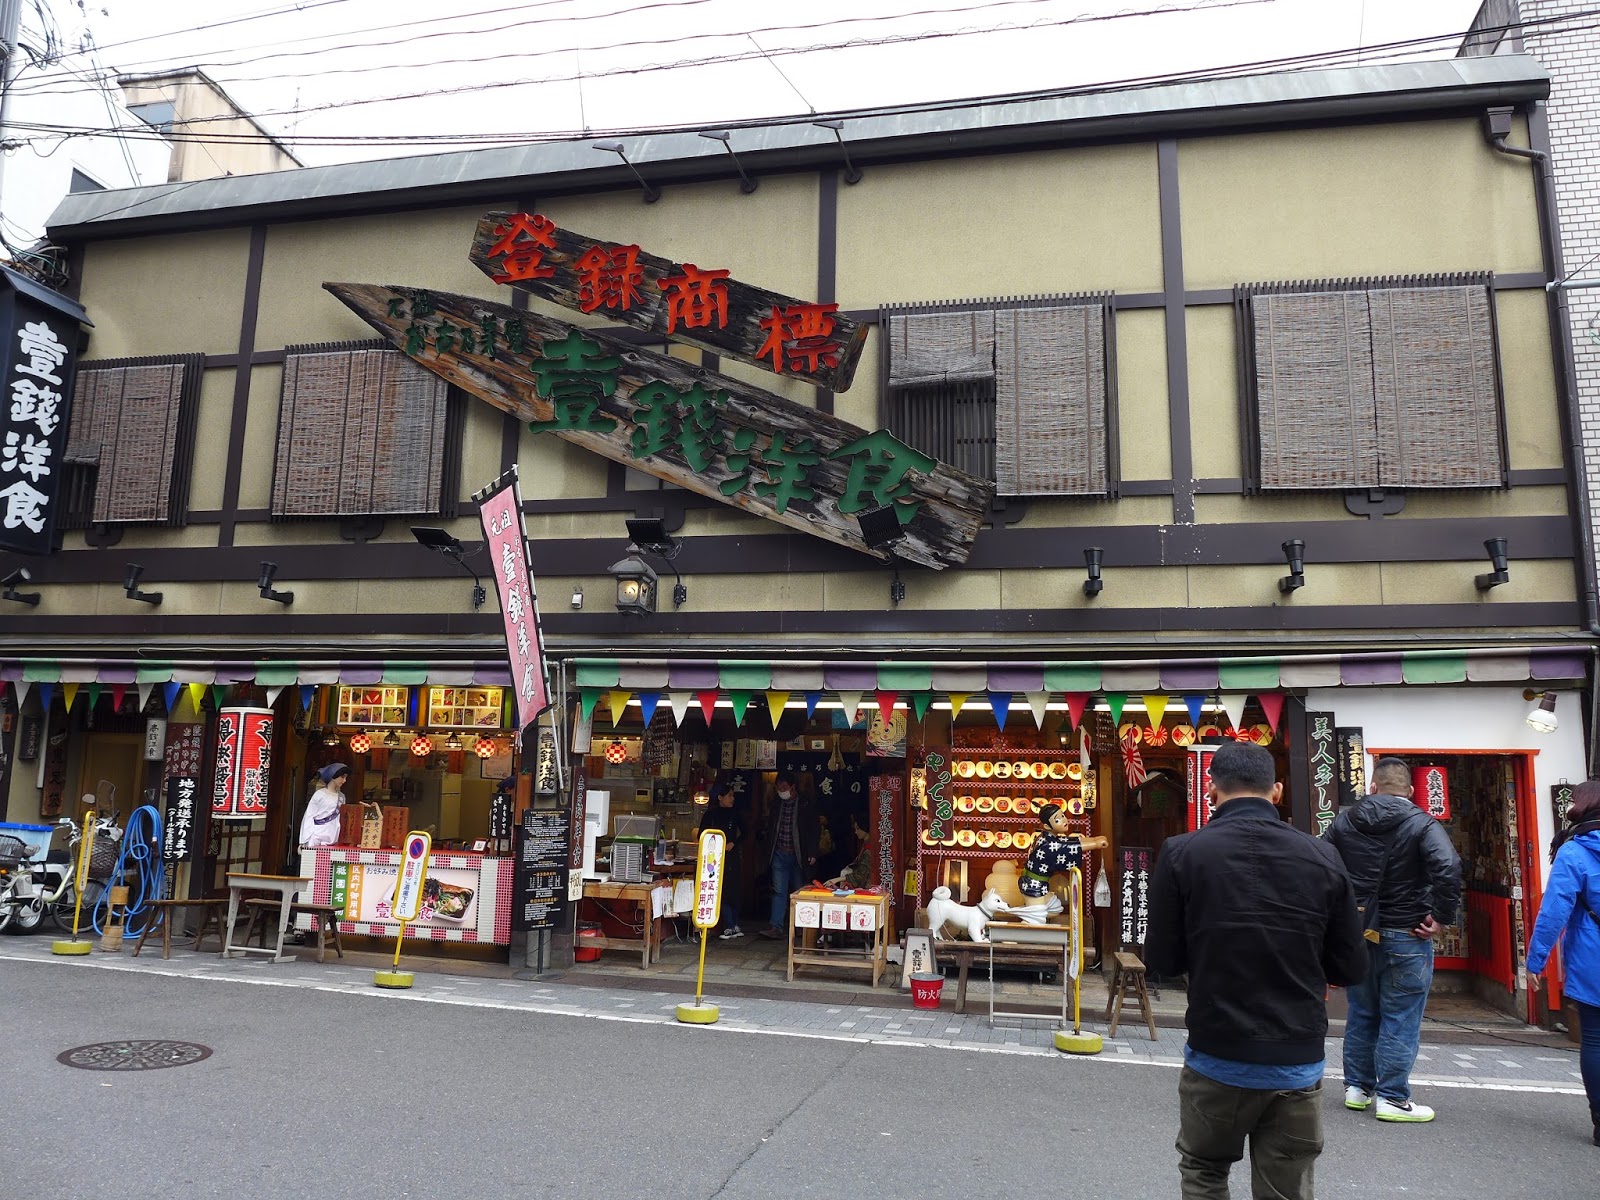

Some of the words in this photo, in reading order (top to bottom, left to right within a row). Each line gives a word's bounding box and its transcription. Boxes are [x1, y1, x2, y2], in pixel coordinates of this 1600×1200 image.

[487, 212, 840, 374] 登録商標
[490, 509, 513, 536] 元祖
[926, 752, 953, 838] やってるよ
[173, 779, 195, 859] 地方発送承ります
[363, 822, 371, 847] 出来ます
[372, 822, 380, 847] 食べ歩き
[366, 867, 399, 877] お好み焼
